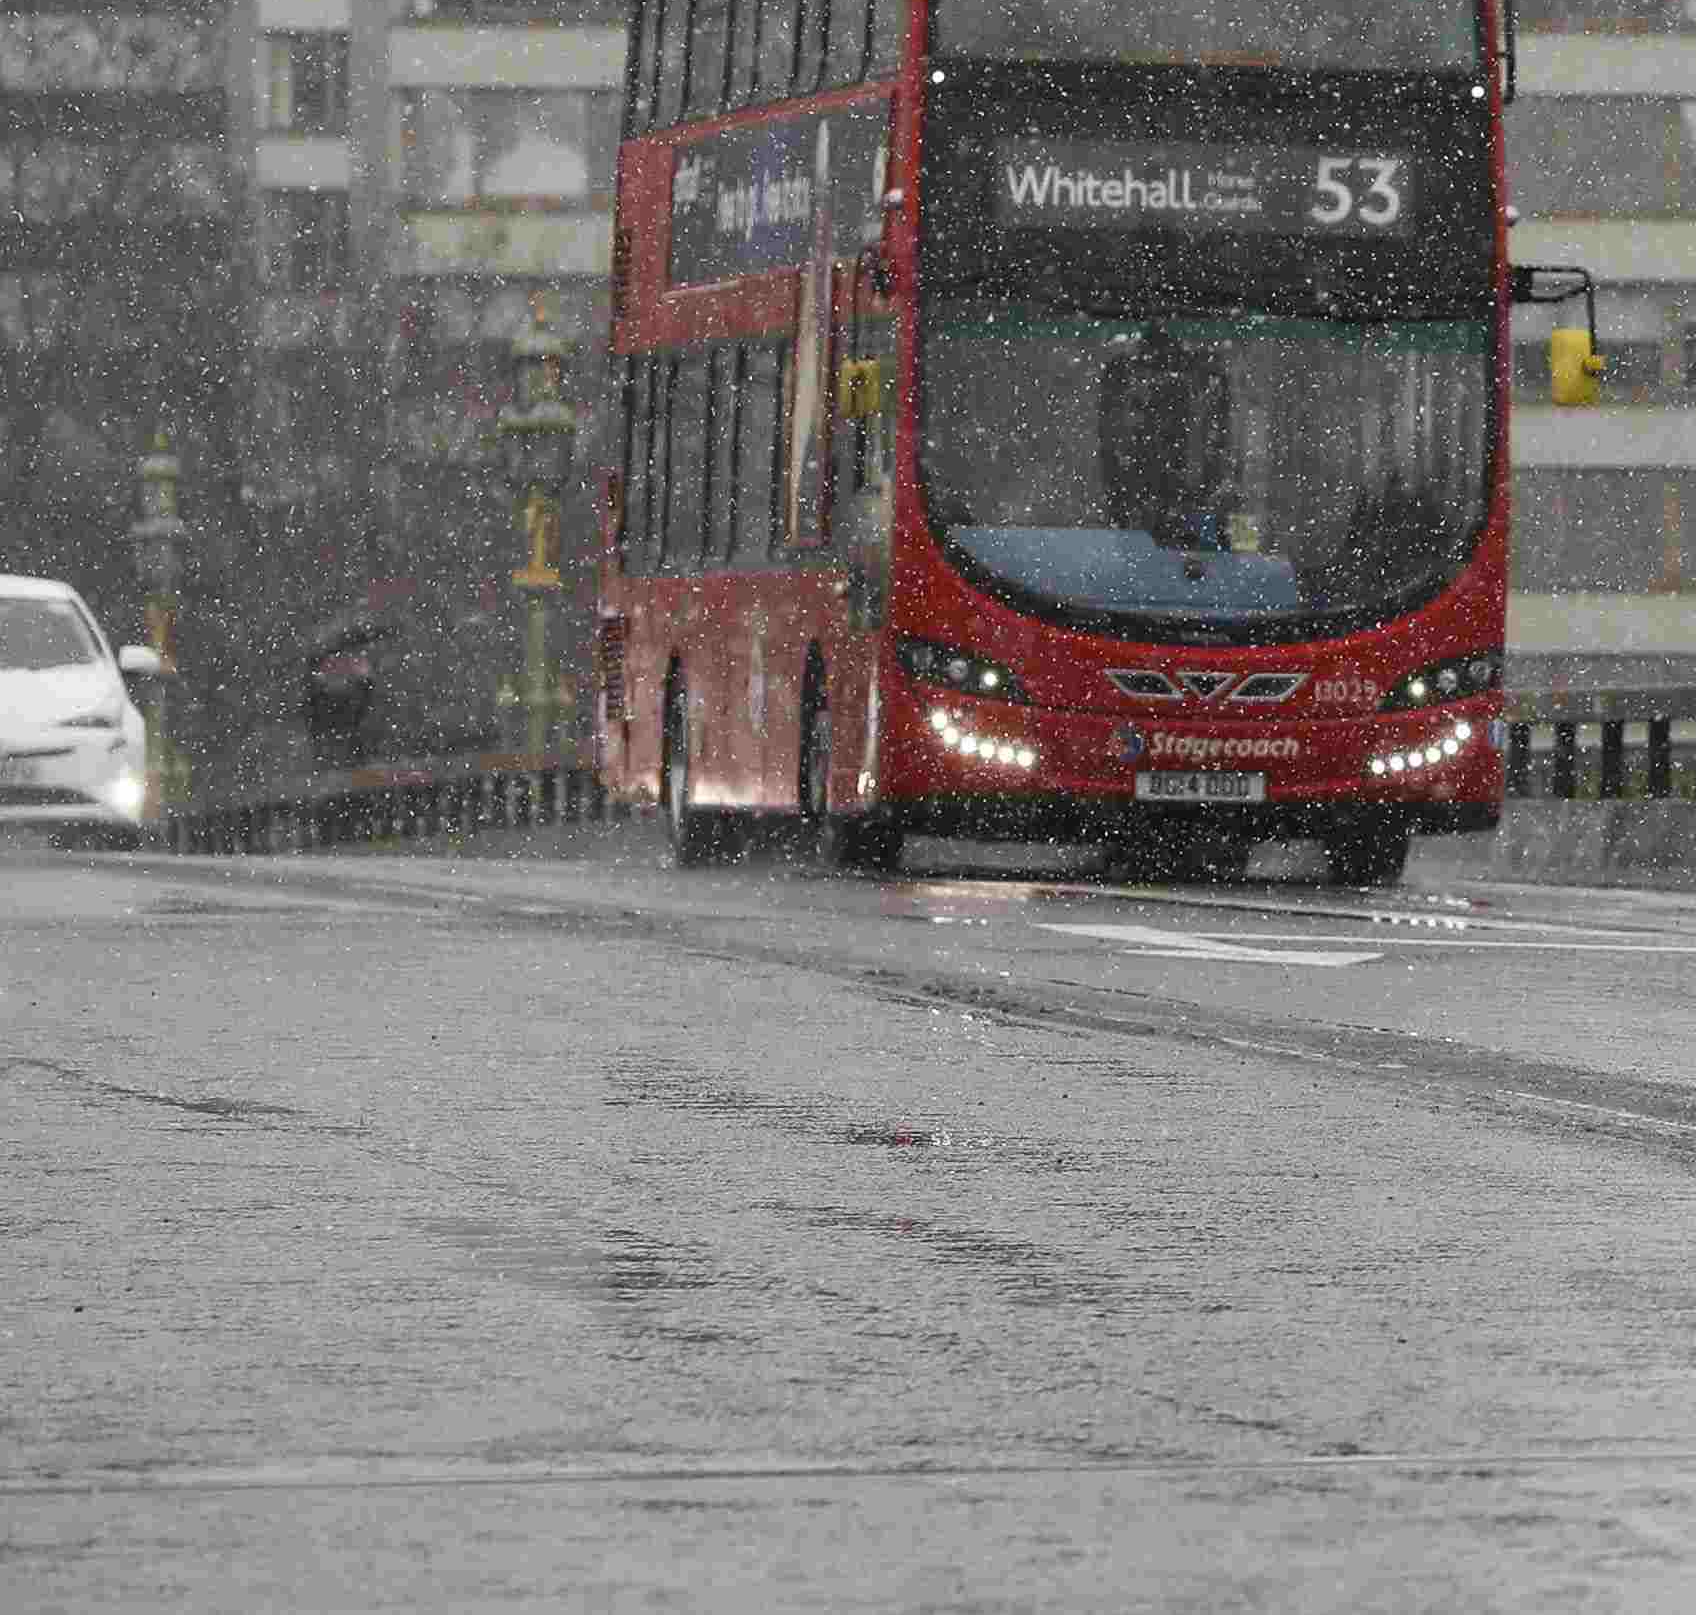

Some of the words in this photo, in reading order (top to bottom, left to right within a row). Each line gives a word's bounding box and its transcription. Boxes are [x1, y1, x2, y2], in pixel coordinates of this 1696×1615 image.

[1006, 163, 1197, 212] Whitehall
[1312, 155, 1402, 226] 53
[1151, 731, 1299, 762] Stagecoach
